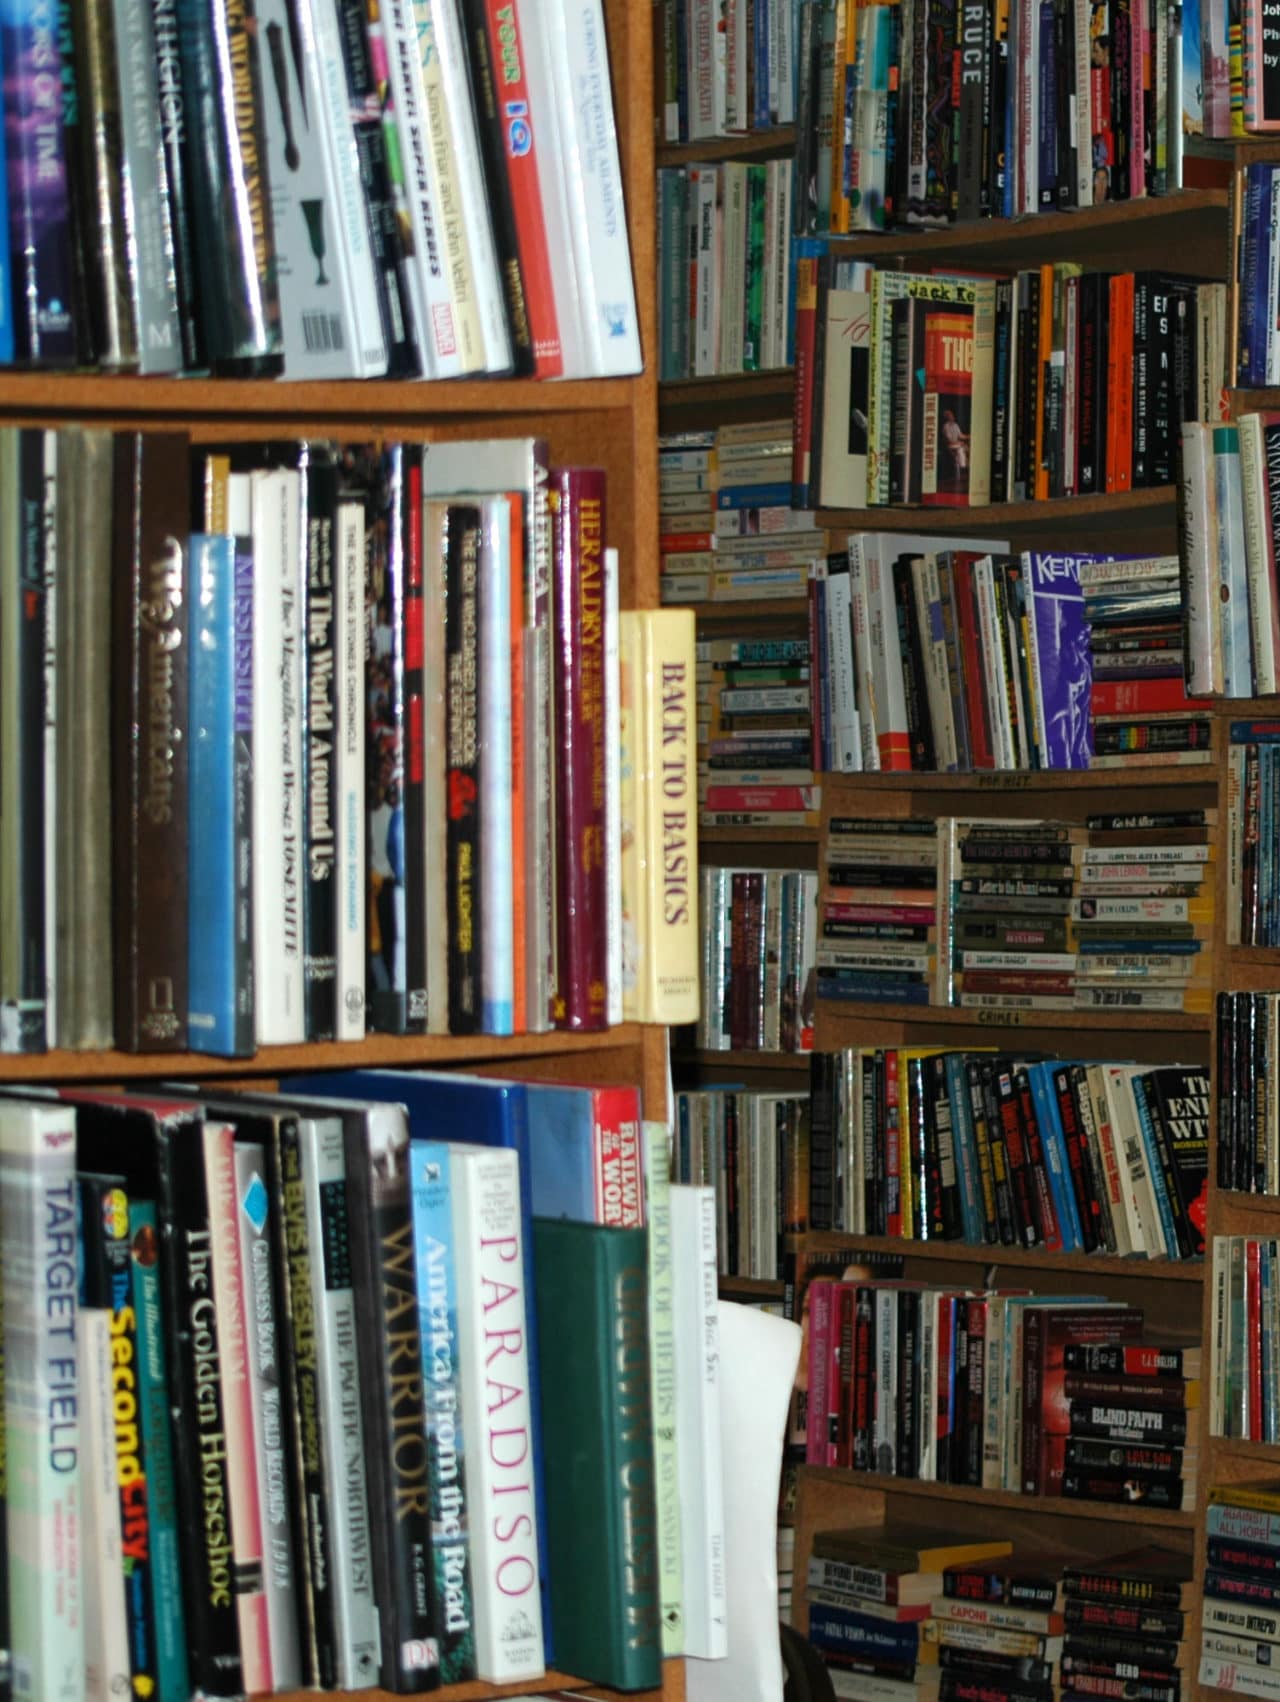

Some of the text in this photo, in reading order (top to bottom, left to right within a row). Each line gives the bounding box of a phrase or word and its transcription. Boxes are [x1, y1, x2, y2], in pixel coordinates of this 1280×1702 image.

[497, 5, 521, 86] YOUR
[505, 100, 534, 158] IQ
[578, 500, 602, 647] HERALDRY
[310, 592, 335, 882] The World Around Us
[662, 660, 690, 928] BACK TO BASICS
[863, 1072, 874, 1180] THE UNDERBOSS
[46, 1179, 75, 1343] TARGET
[253, 1239, 274, 1321] GUINNESS
[284, 1183, 316, 1371] ELVIS PRESLEY
[49, 1357, 77, 1477] FIELD
[257, 1321, 277, 1371] BOOK
[338, 1360, 363, 1444] PACIFIC
[380, 1220, 431, 1523] WARRIOR
[480, 1233, 536, 1600] PARADISO
[1092, 1405, 1164, 1431] BLIND FAITH
[108, 1304, 149, 1562] Second City
[185, 1228, 234, 1610] The Golden Horseshoe
[425, 1236, 470, 1635] America From the Road
[342, 1452, 369, 1596] NORTHWEST
[951, 1604, 988, 1621] CAPONE
[1115, 1662, 1139, 1678] HERO
